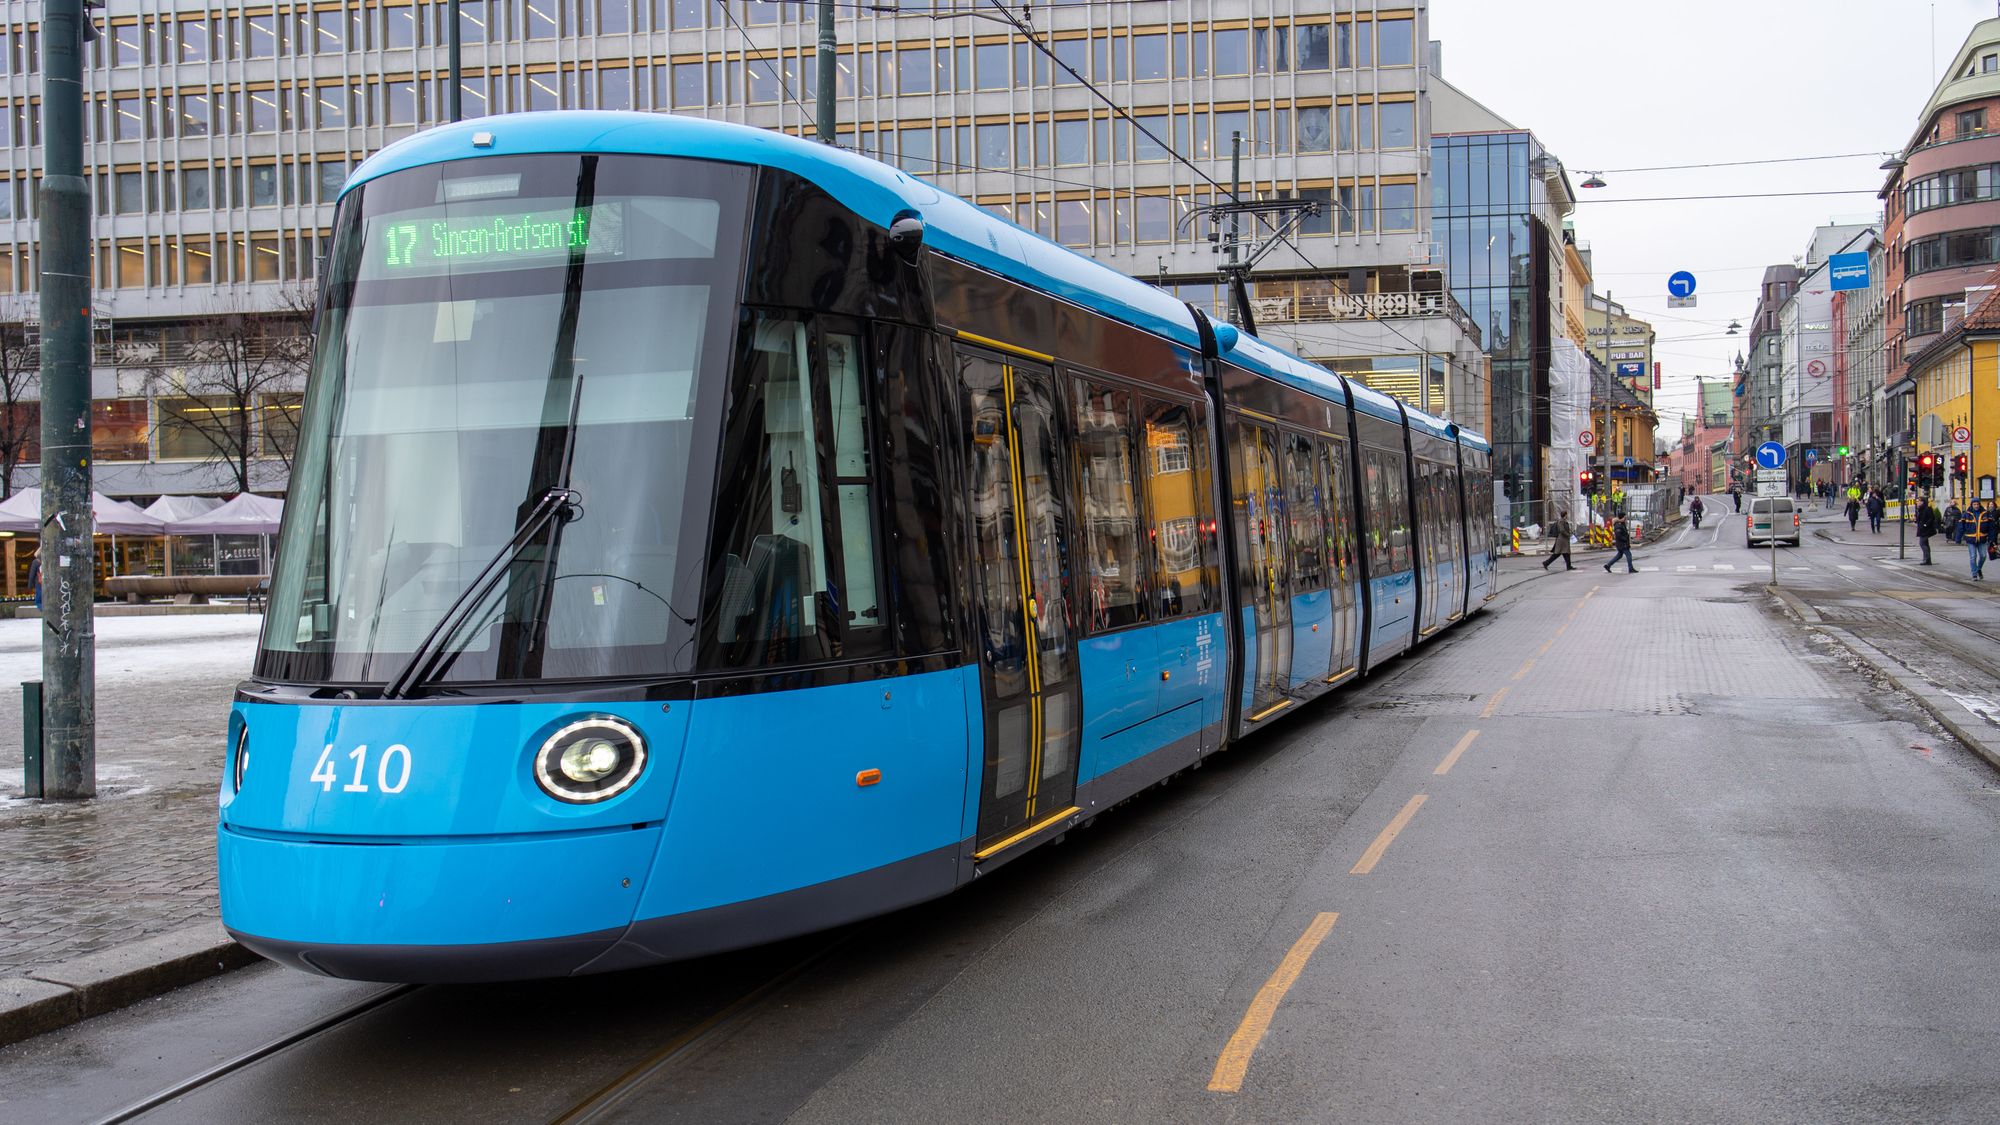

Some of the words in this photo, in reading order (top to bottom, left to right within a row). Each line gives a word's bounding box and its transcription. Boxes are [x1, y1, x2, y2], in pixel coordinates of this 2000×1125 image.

[387, 225, 417, 265] 17
[432, 216, 562, 257] Sinsen-Grefsen
[310, 743, 412, 793] 410
